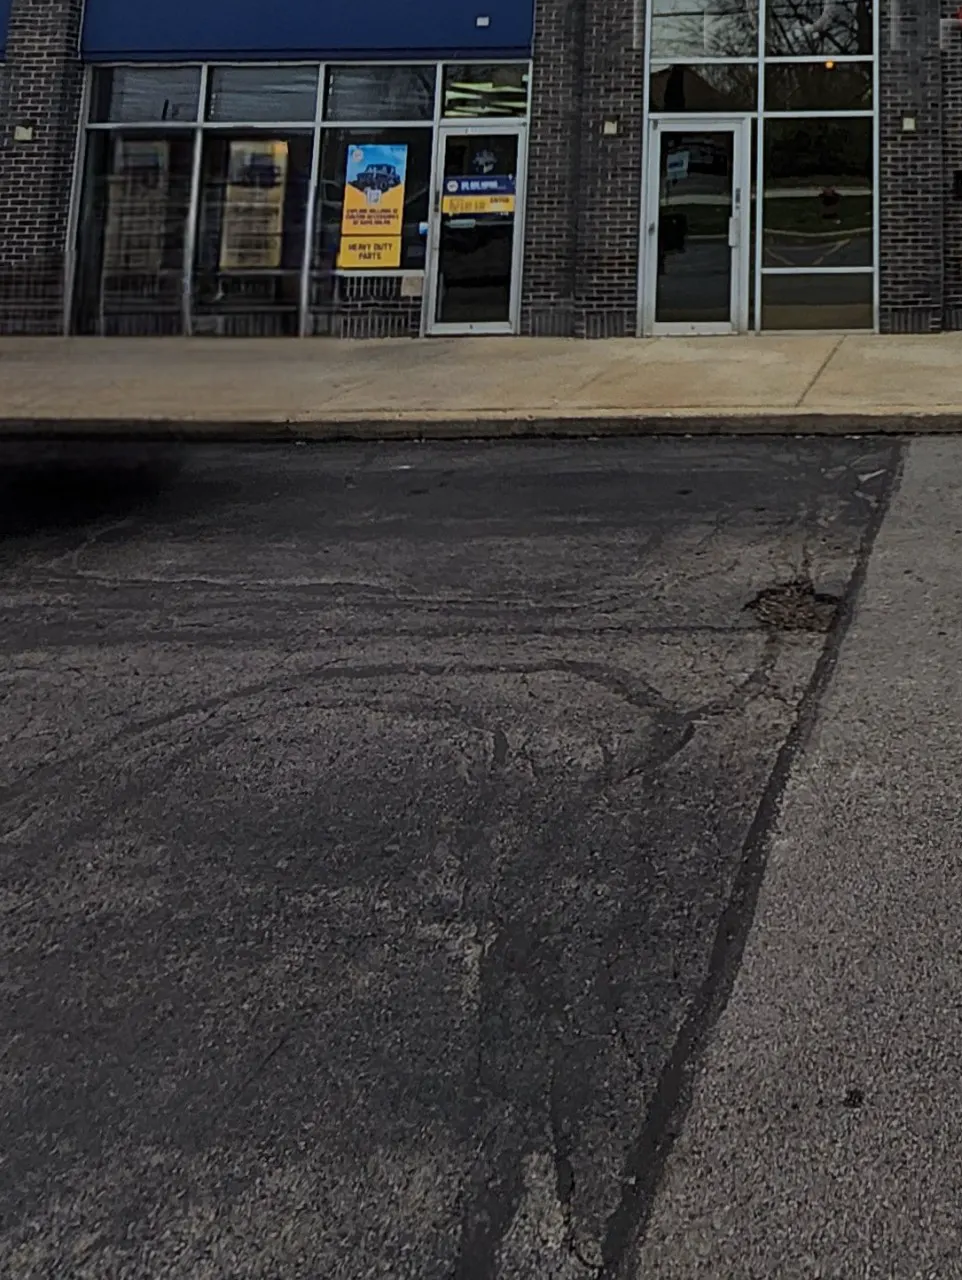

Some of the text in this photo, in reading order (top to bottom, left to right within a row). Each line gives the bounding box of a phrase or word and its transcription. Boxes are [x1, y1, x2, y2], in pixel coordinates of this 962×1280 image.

[348, 242, 393, 251] HEAVY DUTY
[358, 252, 382, 260] PARTS
